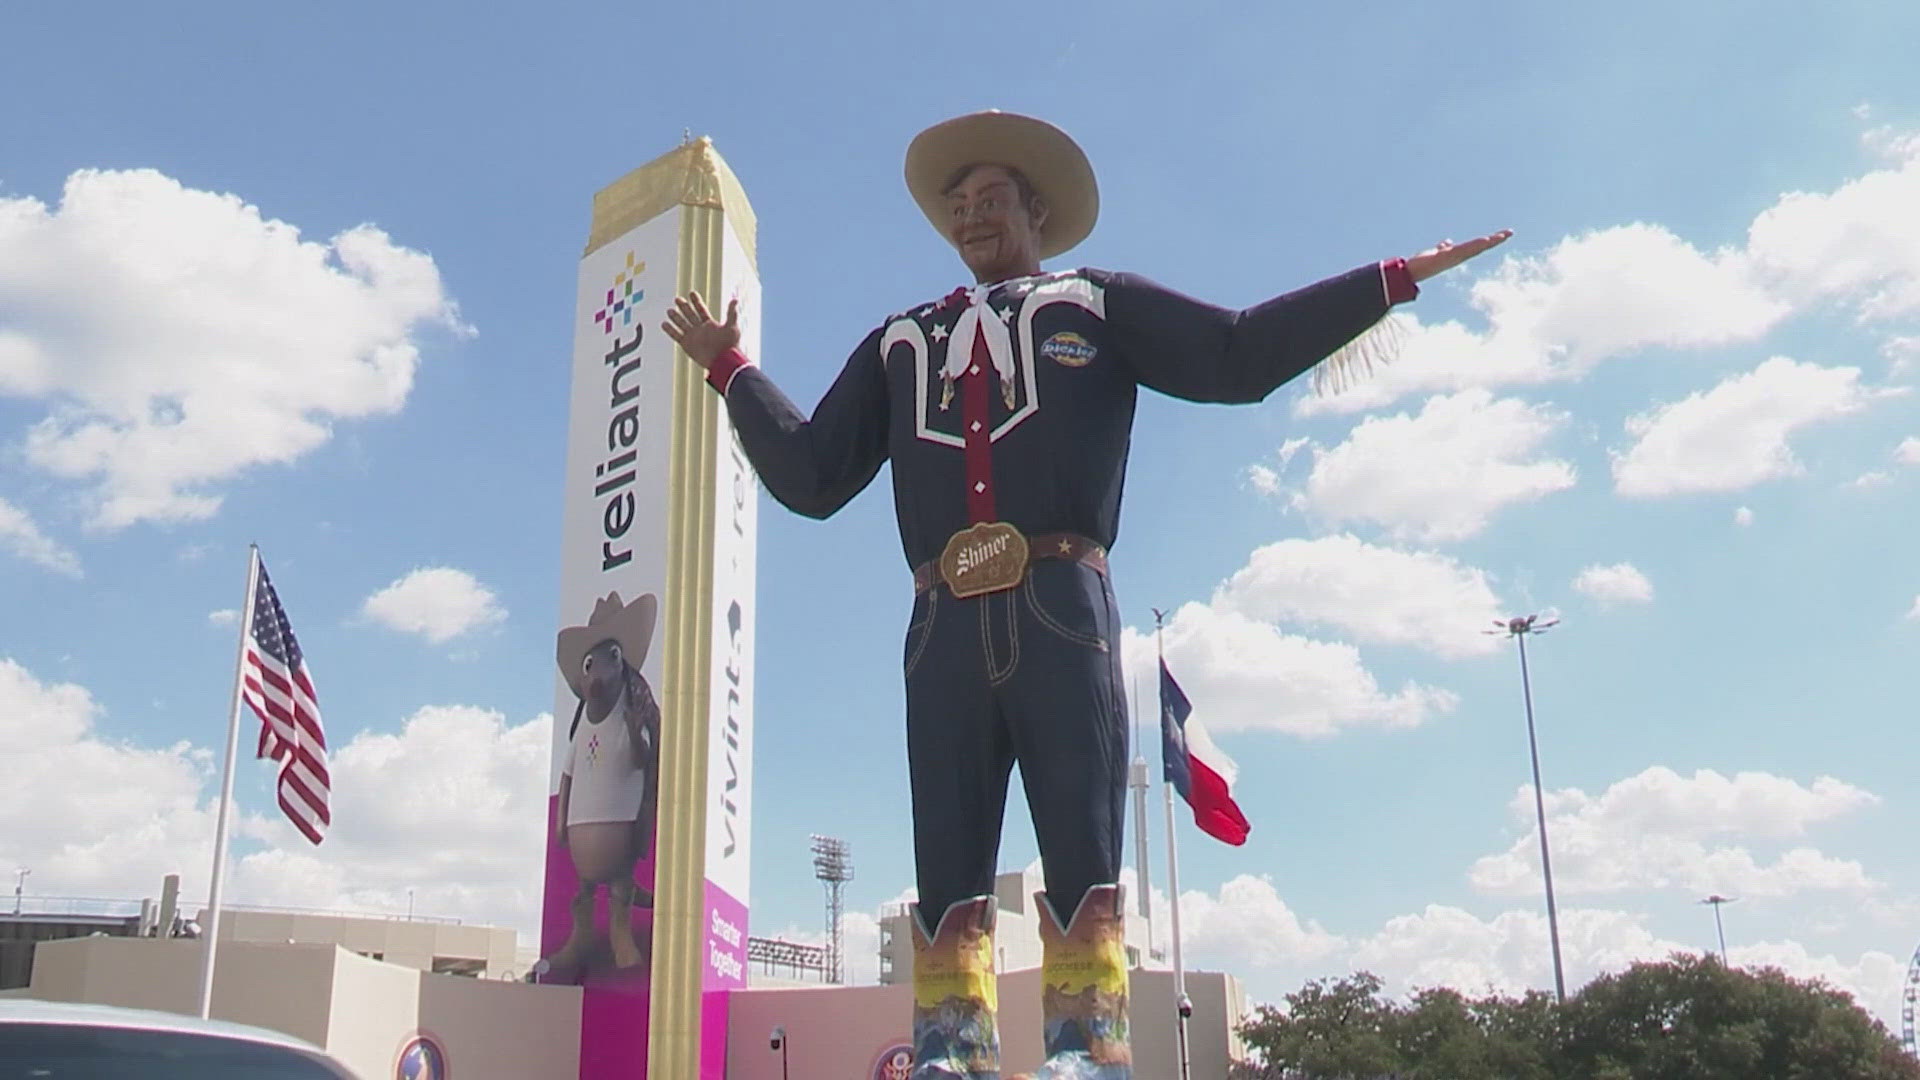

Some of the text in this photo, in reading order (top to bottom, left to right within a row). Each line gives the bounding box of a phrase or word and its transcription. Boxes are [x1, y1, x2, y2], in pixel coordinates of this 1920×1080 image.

[595, 322, 644, 572] reliant
[956, 533, 1010, 577] Shiner
[720, 655, 740, 859] vivint
[712, 908, 741, 949] Smarter
[709, 939, 743, 981] Together
